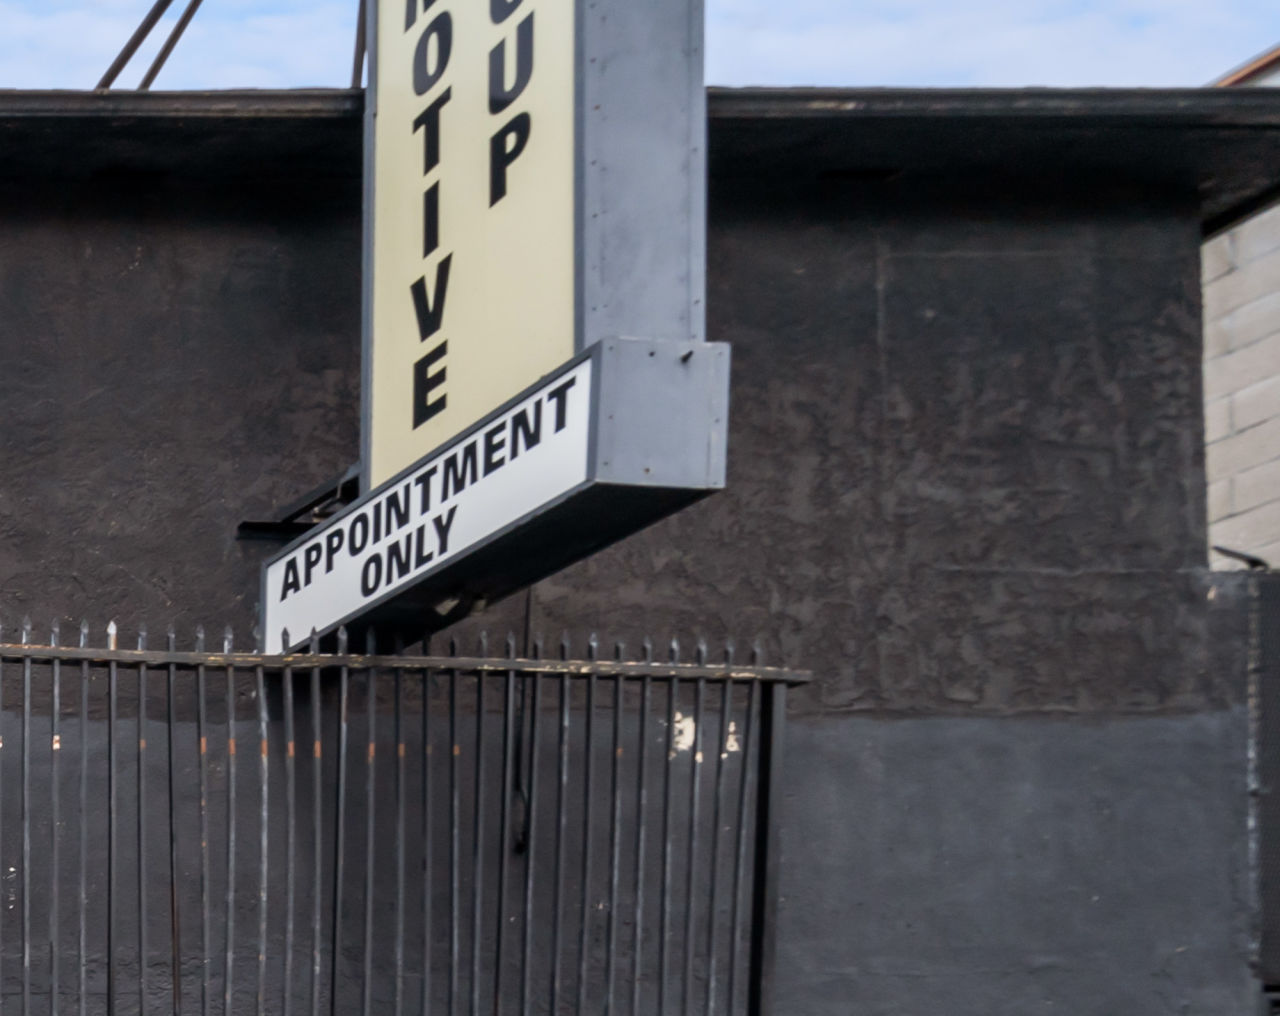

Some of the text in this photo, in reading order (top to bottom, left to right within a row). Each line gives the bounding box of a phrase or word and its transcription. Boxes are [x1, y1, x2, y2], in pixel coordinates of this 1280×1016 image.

[488, 0, 535, 209] UP
[280, 375, 577, 603] APPOINTMENT
[360, 504, 458, 598] ONLY
